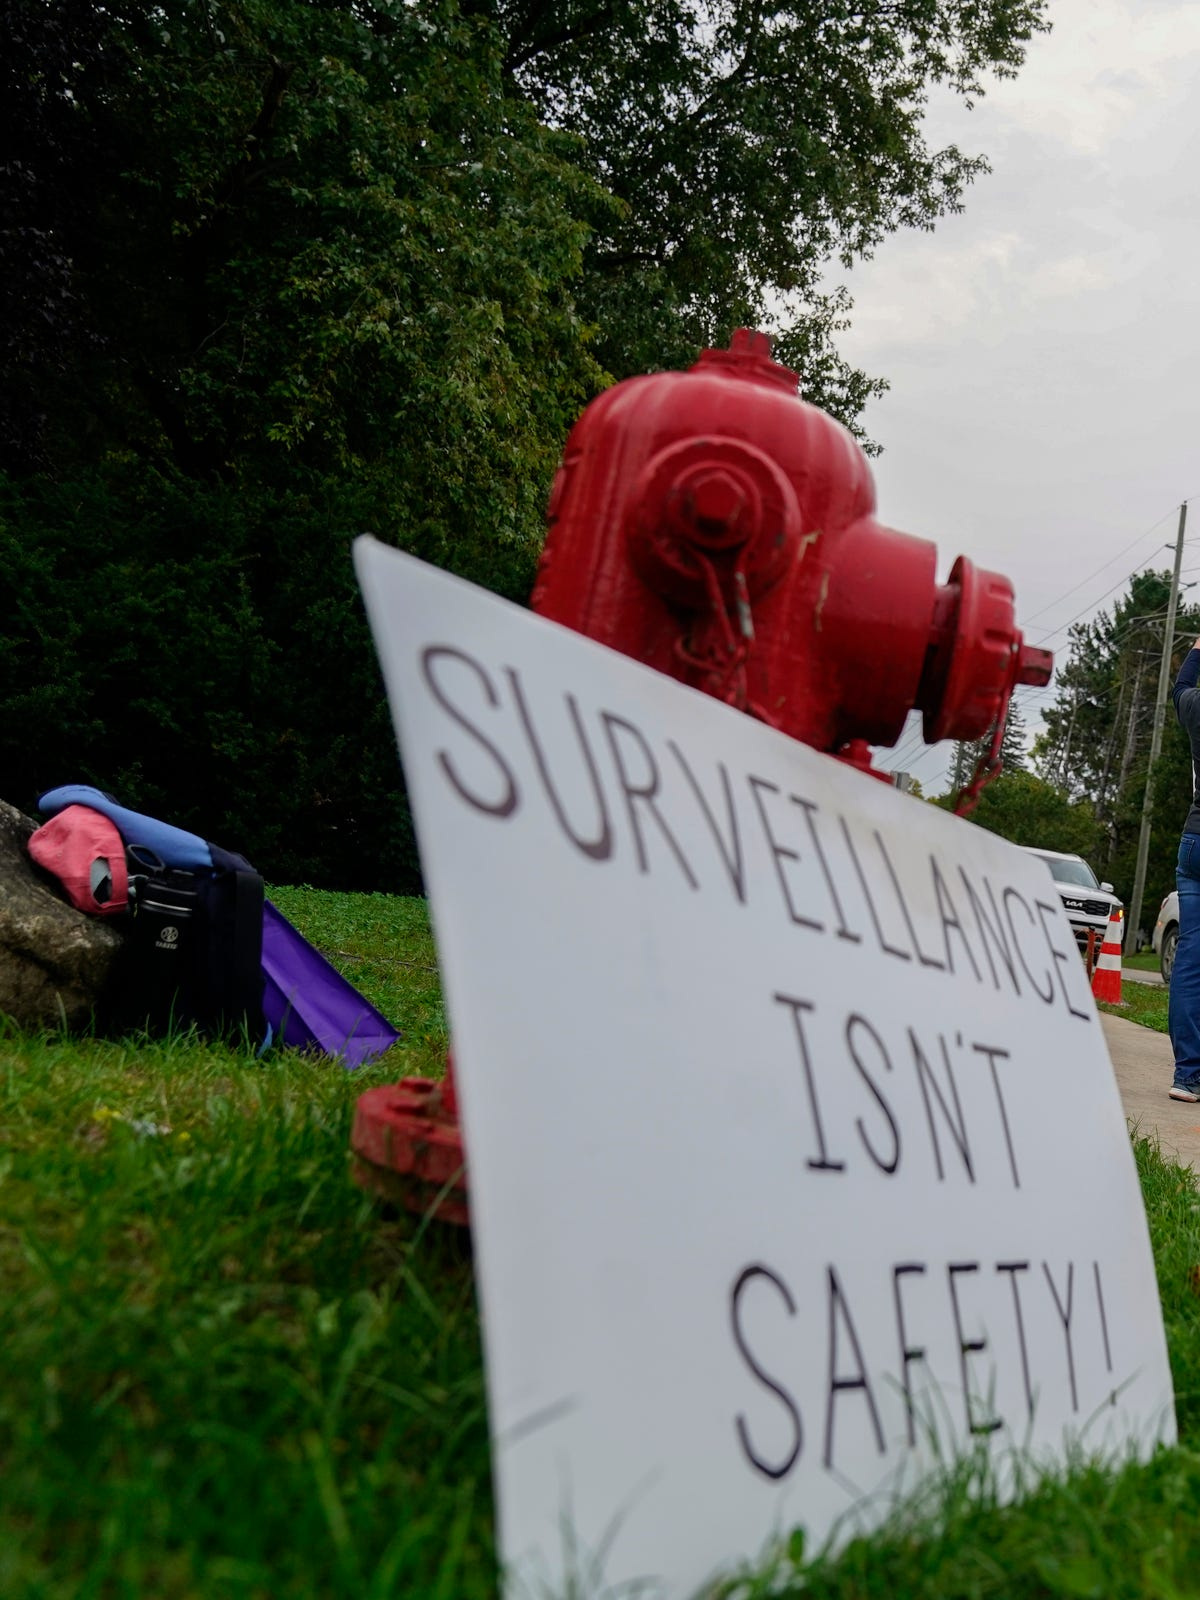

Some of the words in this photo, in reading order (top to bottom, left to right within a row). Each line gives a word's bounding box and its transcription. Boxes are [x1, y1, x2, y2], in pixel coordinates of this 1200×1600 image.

[420, 643, 1091, 1022] SURVEILLANCE
[773, 990, 1021, 1189] ISN'T
[730, 1259, 1117, 1481] SAFETY!
